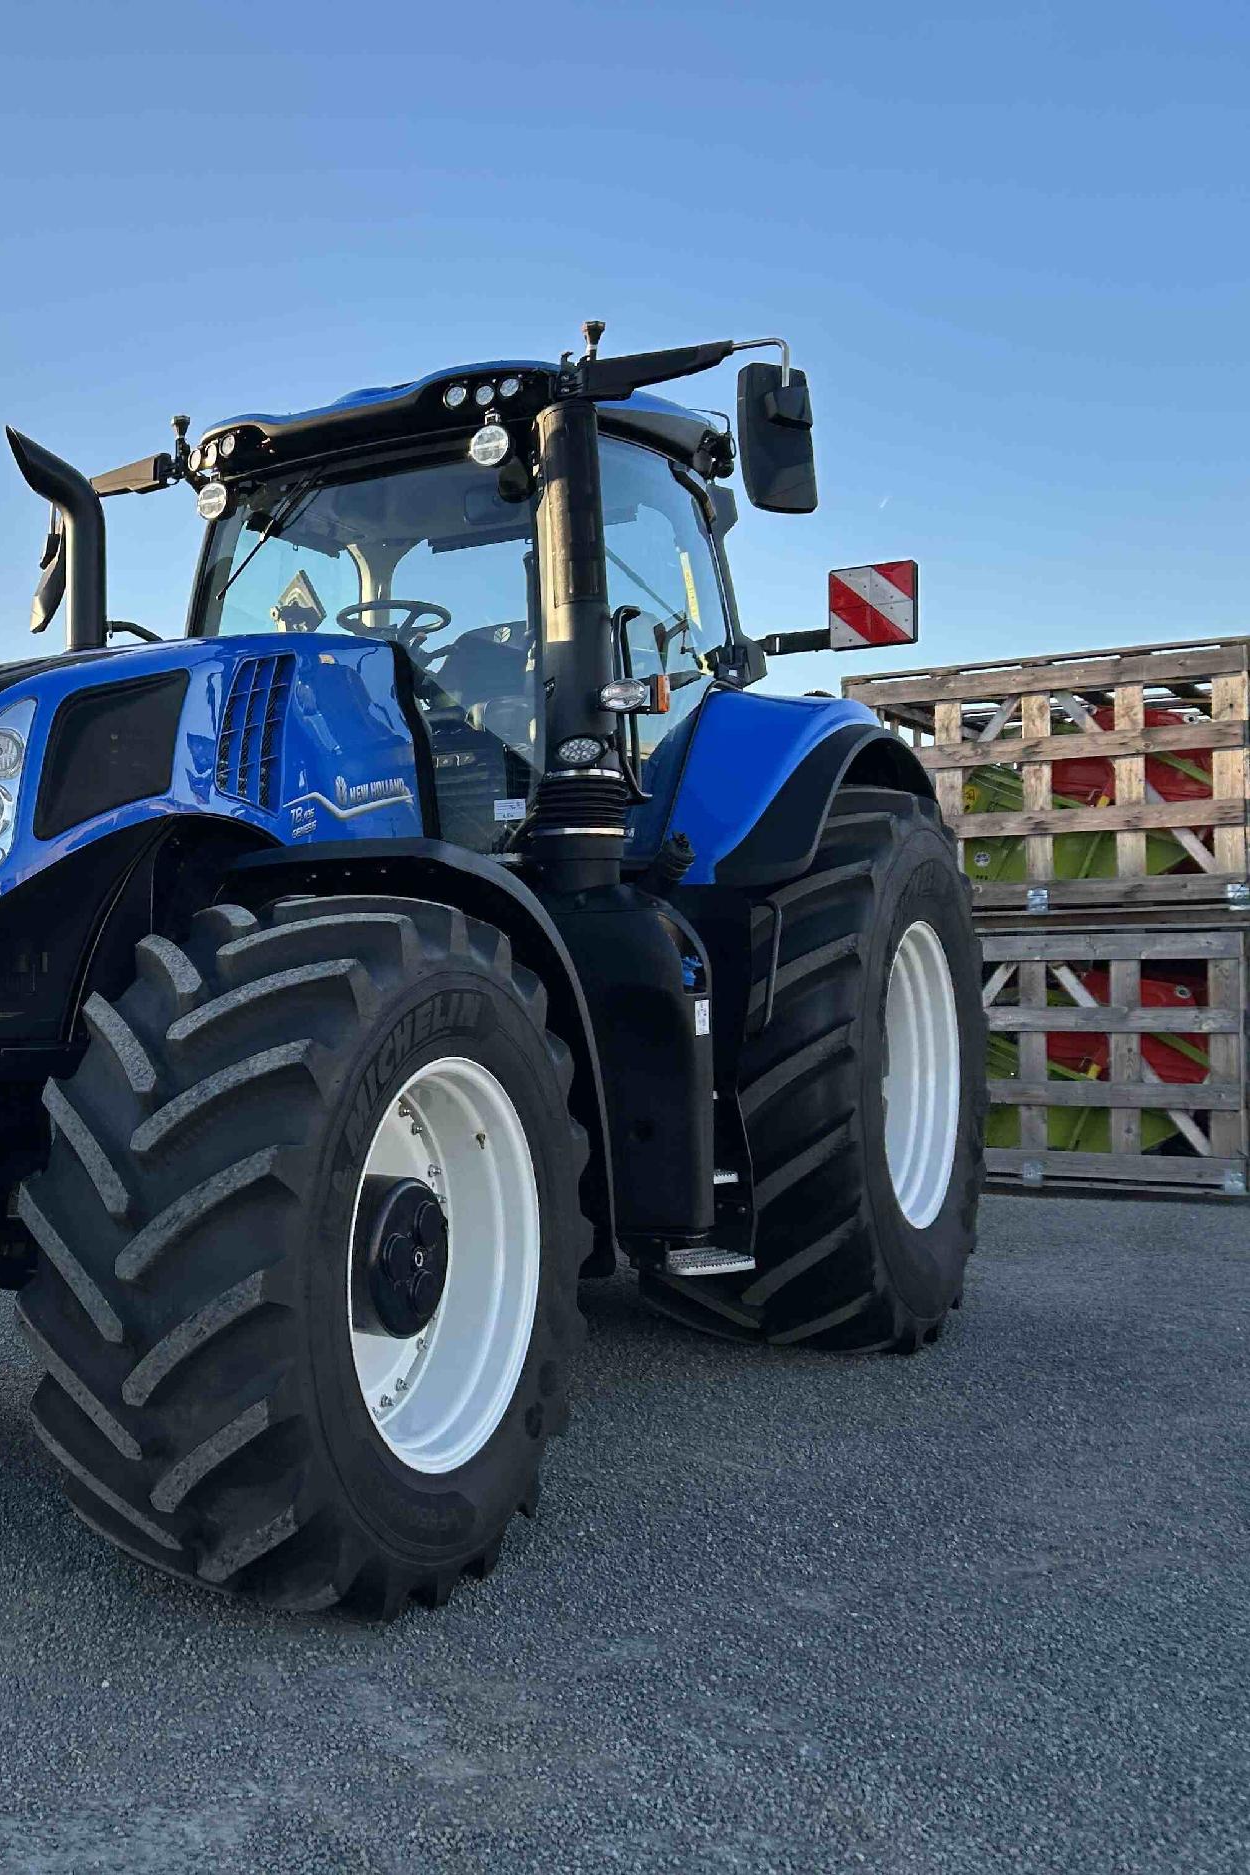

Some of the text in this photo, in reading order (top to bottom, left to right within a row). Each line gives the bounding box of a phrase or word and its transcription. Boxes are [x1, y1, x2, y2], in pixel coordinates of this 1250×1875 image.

[349, 778, 405, 802] NEW HOLLAND
[344, 992, 485, 1156] MICHELIN
